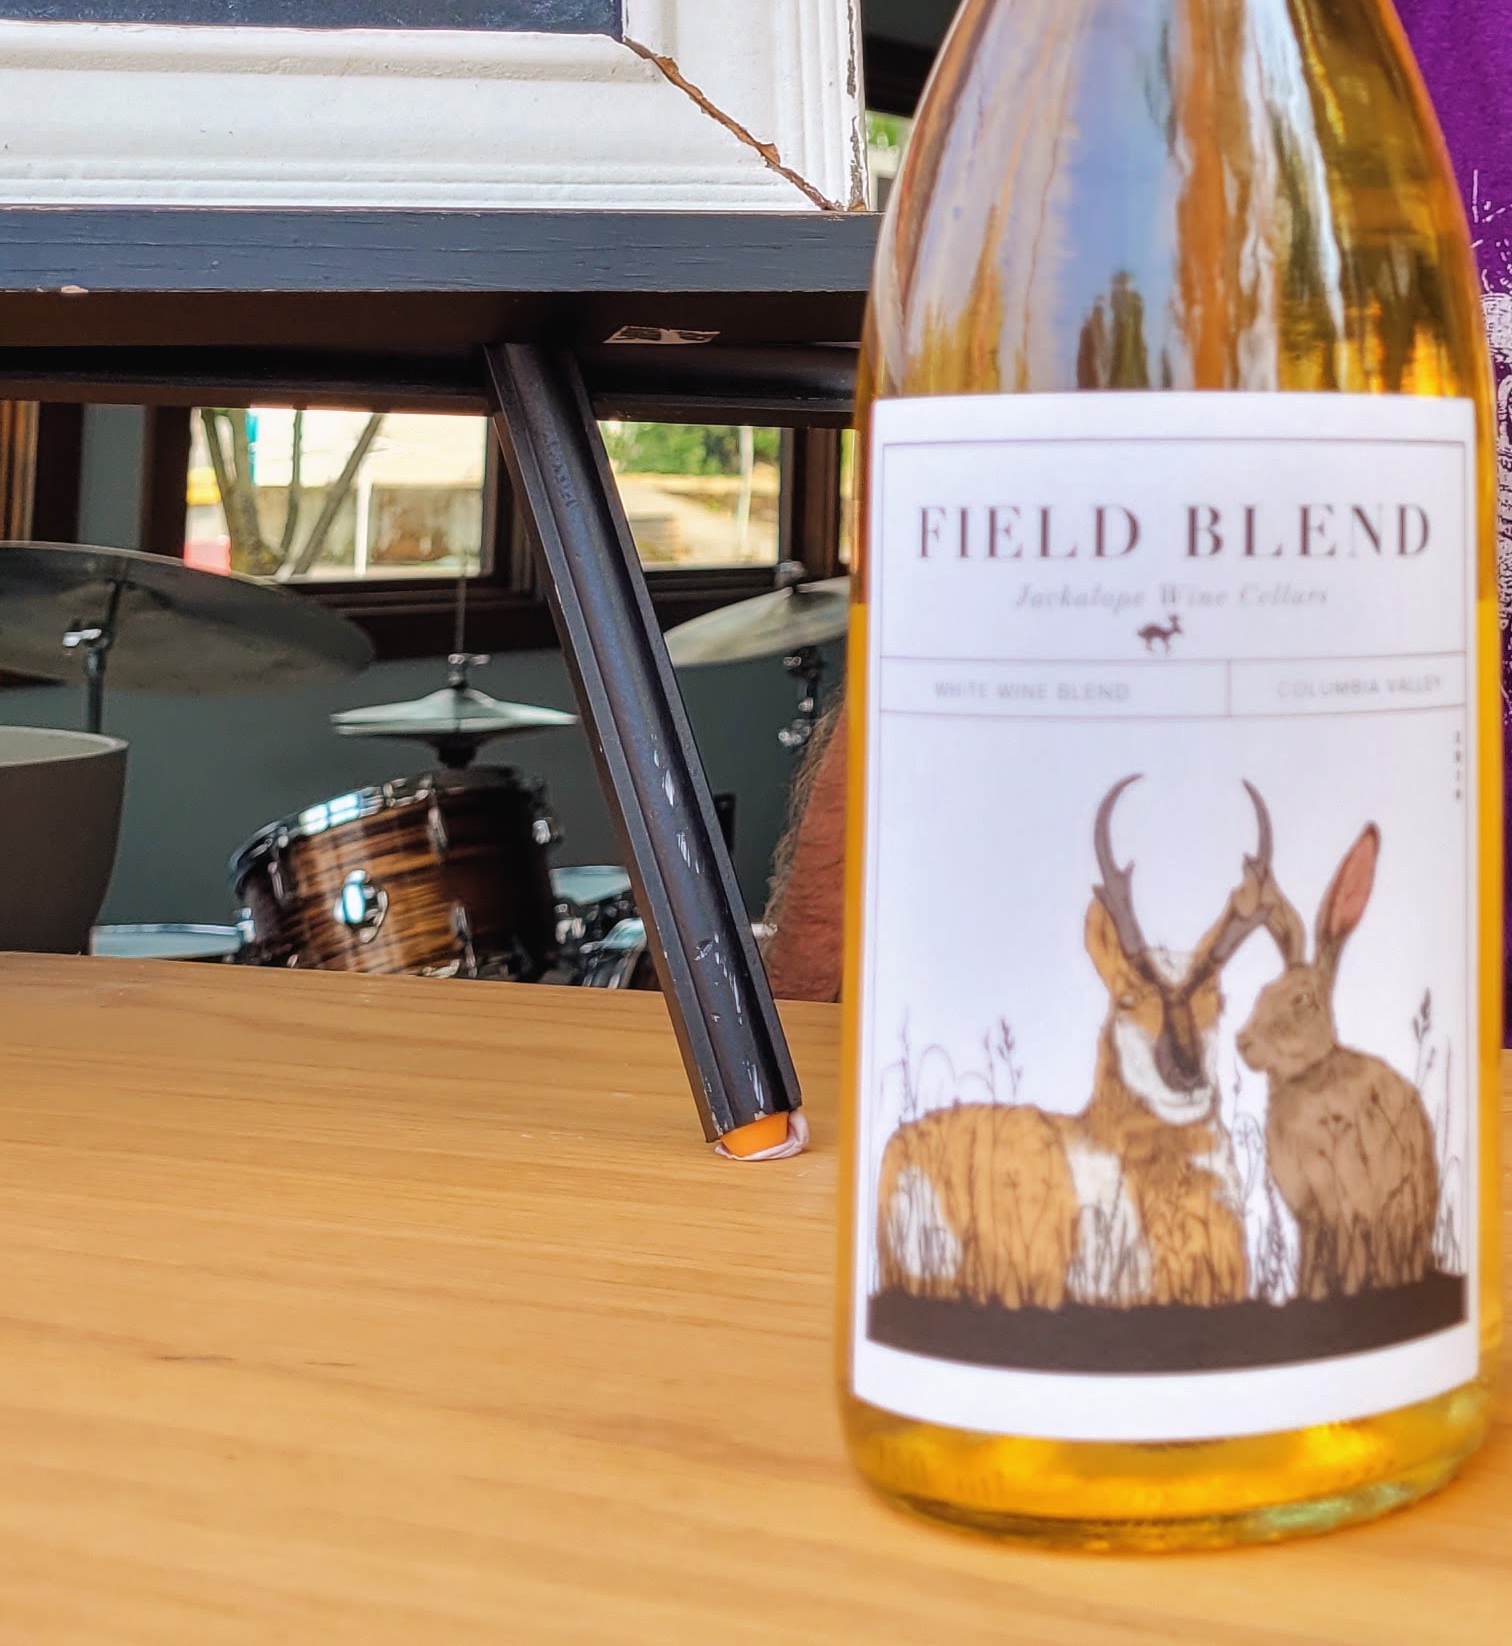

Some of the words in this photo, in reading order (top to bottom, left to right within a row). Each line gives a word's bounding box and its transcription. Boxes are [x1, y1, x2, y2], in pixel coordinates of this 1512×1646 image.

[918, 504, 1142, 560] FIELD
[1184, 502, 1432, 558] BLEND
[1159, 583, 1228, 604] Wine
[1239, 583, 1329, 604] Cellars
[934, 681, 989, 700] WHITE
[995, 681, 1049, 700] WINE
[1055, 682, 1131, 702] BLEND
[1277, 678, 1380, 699] COLUMBIA
[1386, 674, 1441, 693] VALLEY
